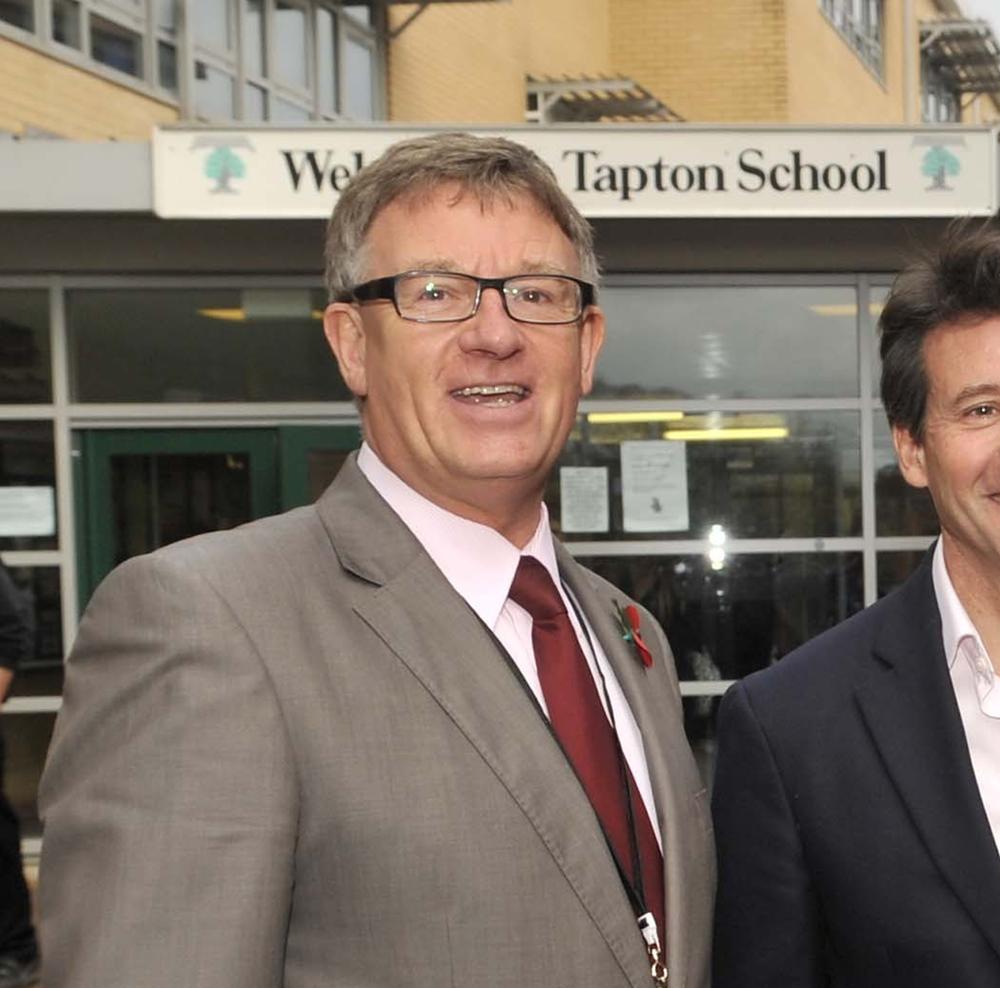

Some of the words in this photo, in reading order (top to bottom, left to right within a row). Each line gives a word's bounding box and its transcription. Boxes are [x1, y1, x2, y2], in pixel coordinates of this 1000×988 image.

[279, 149, 364, 193] Wel
[562, 149, 727, 200] Tapton
[737, 148, 890, 192] School
